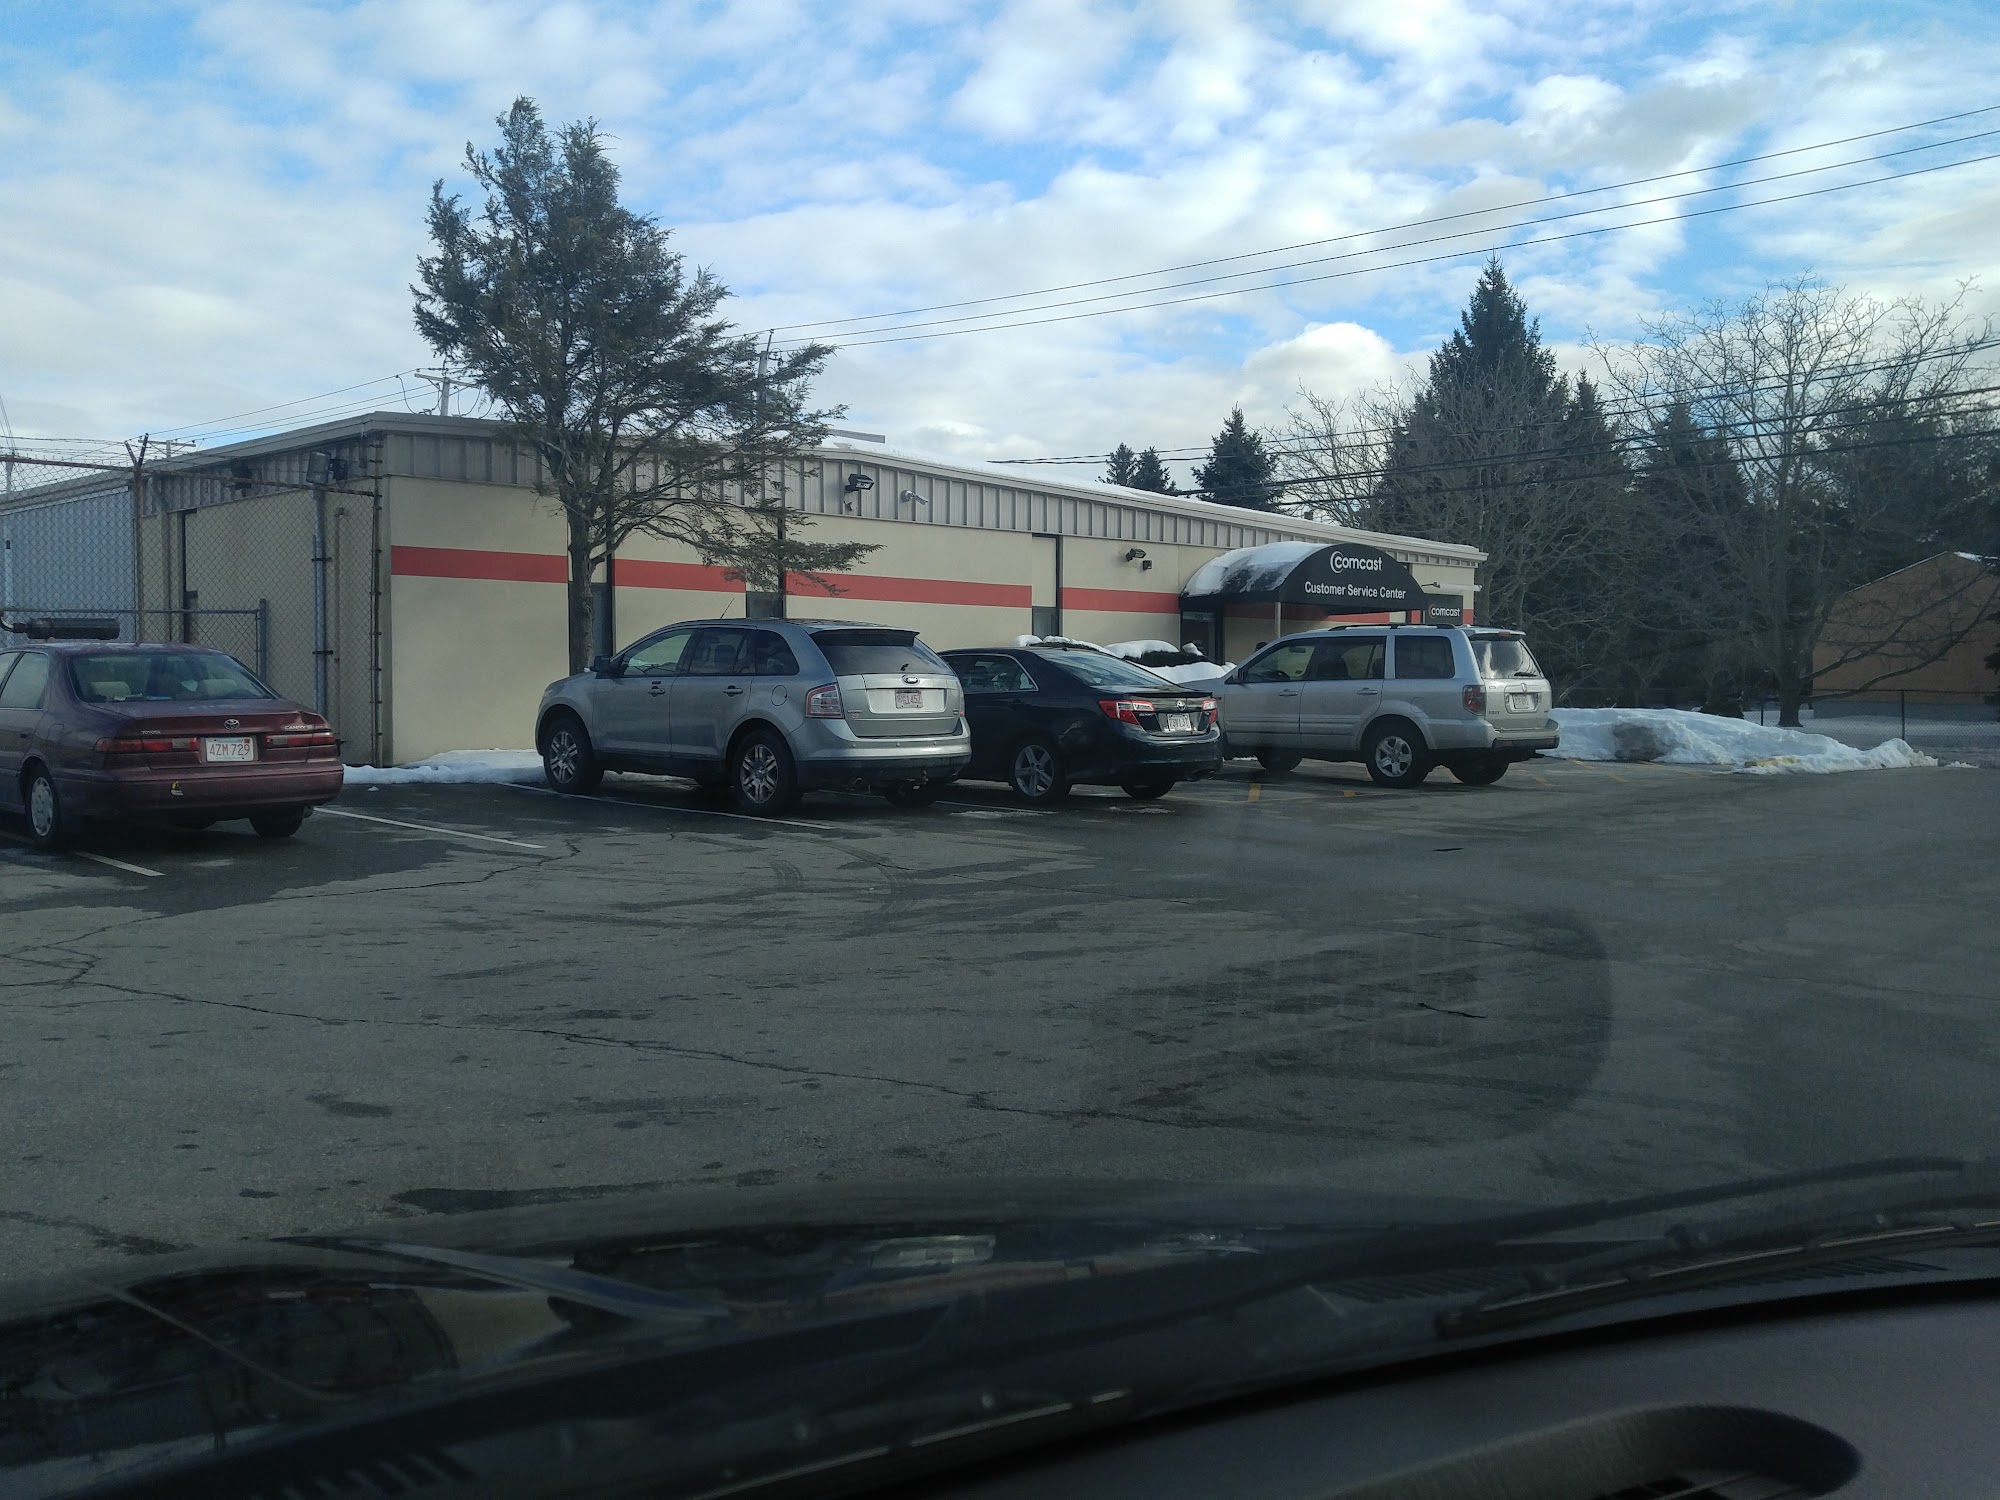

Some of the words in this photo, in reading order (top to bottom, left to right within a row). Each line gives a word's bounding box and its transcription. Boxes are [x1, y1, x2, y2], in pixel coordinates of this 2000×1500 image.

[1304, 581, 1346, 596] Customer
[1347, 584, 1378, 598] Service
[1379, 587, 1407, 600] Center
[209, 743, 229, 756] 4ZM
[231, 743, 250, 756] 729
